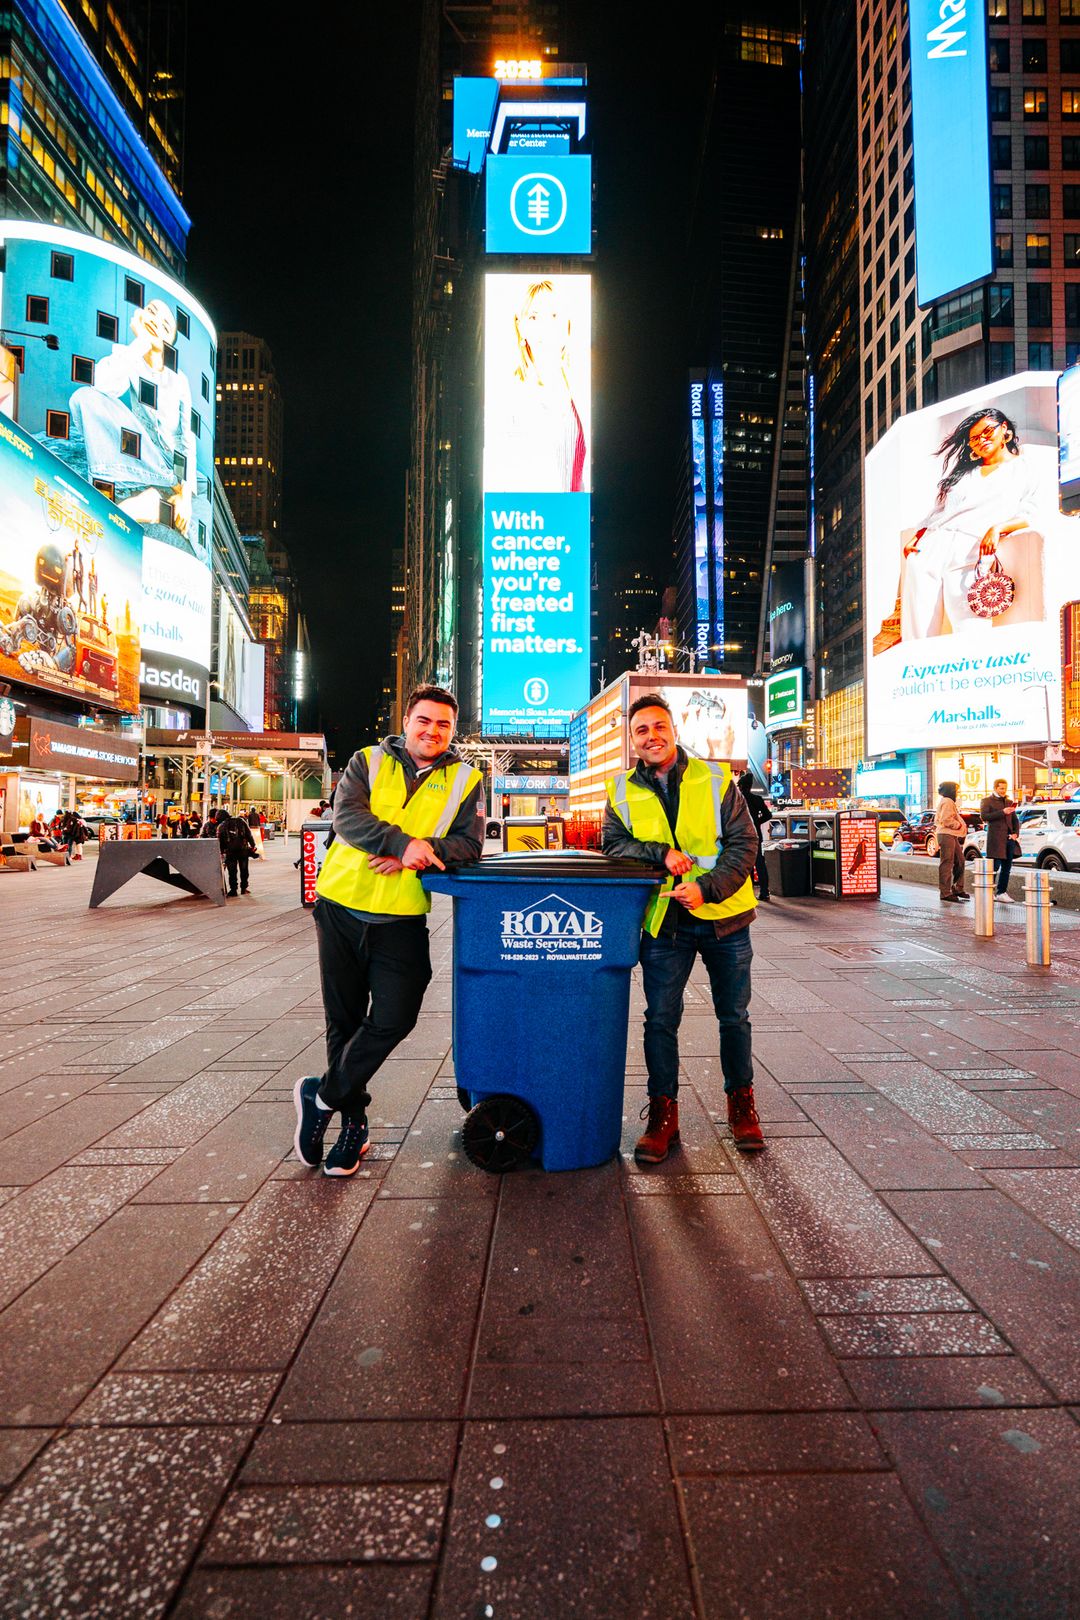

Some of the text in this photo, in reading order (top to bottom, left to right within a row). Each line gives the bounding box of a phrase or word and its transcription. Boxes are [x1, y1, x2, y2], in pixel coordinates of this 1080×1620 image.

[519, 138, 547, 147] Center
[491, 510, 544, 530] With
[491, 535, 571, 554] cancer,
[491, 551, 560, 571] where
[491, 572, 562, 598] you're
[491, 592, 574, 612] treated
[776, 601, 794, 616] hero.
[142, 620, 184, 642] rshalls
[491, 613, 535, 633] first
[491, 635, 583, 653] matters.
[901, 651, 1031, 680] Expensive taste
[950, 676, 970, 690] be
[973, 667, 1057, 689] expensive.
[526, 708, 547, 716] Sloan
[927, 704, 1002, 724] Marshalls
[806, 708, 815, 749] SQUARE
[304, 831, 316, 903] CHICAGO
[501, 911, 603, 935] ROYAL
[502, 938, 602, 950] Waste Services, Inc.
